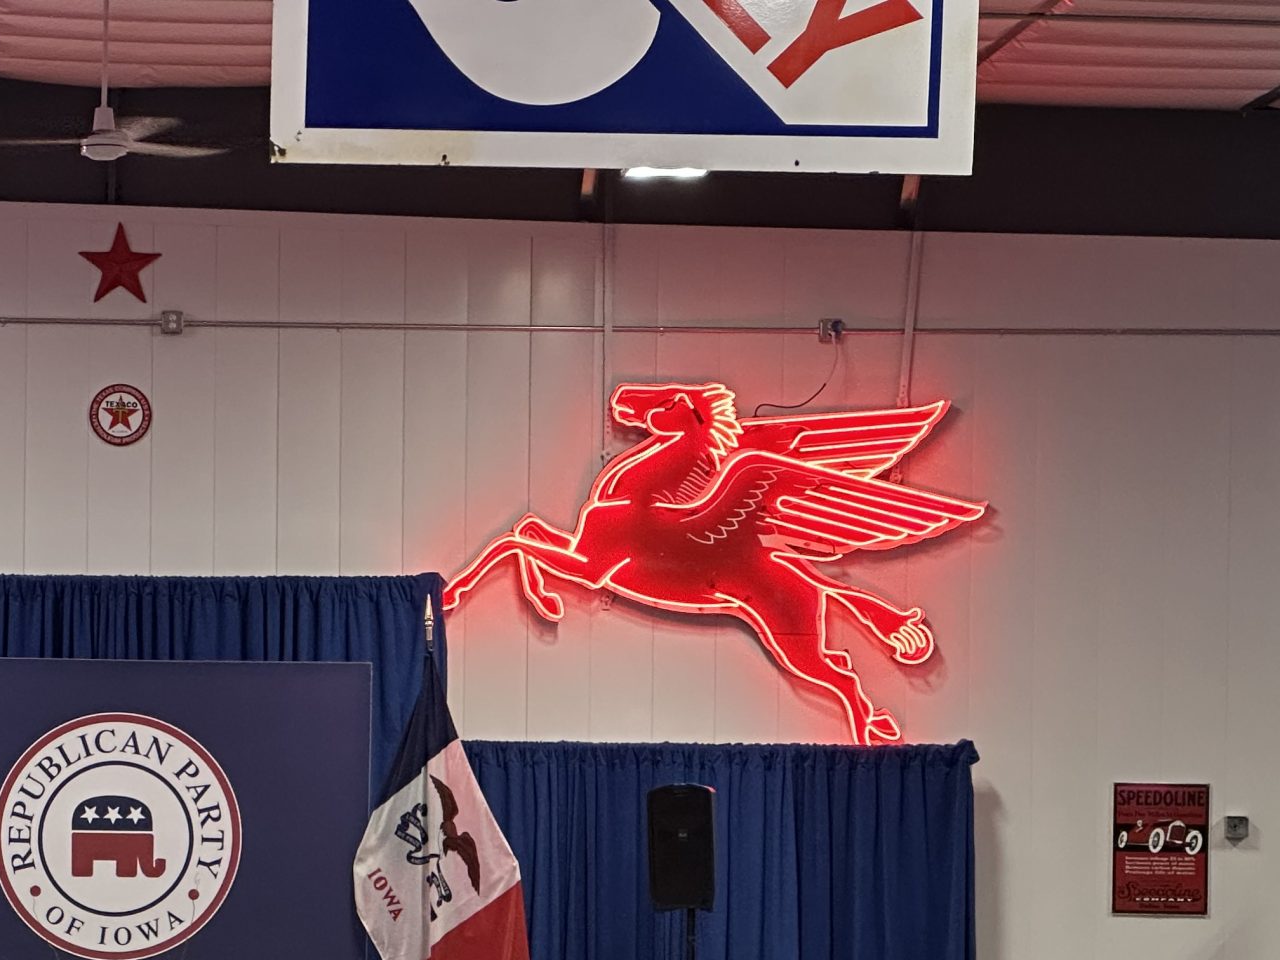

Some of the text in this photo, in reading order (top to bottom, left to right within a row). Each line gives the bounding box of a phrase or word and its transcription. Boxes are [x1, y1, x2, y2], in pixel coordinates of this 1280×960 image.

[9, 729, 224, 879] REPUBLICAN PARTY
[1117, 790, 1205, 806] SPEEDOLINE
[367, 868, 404, 922] IOWA
[45, 906, 184, 946] OF IOWA
